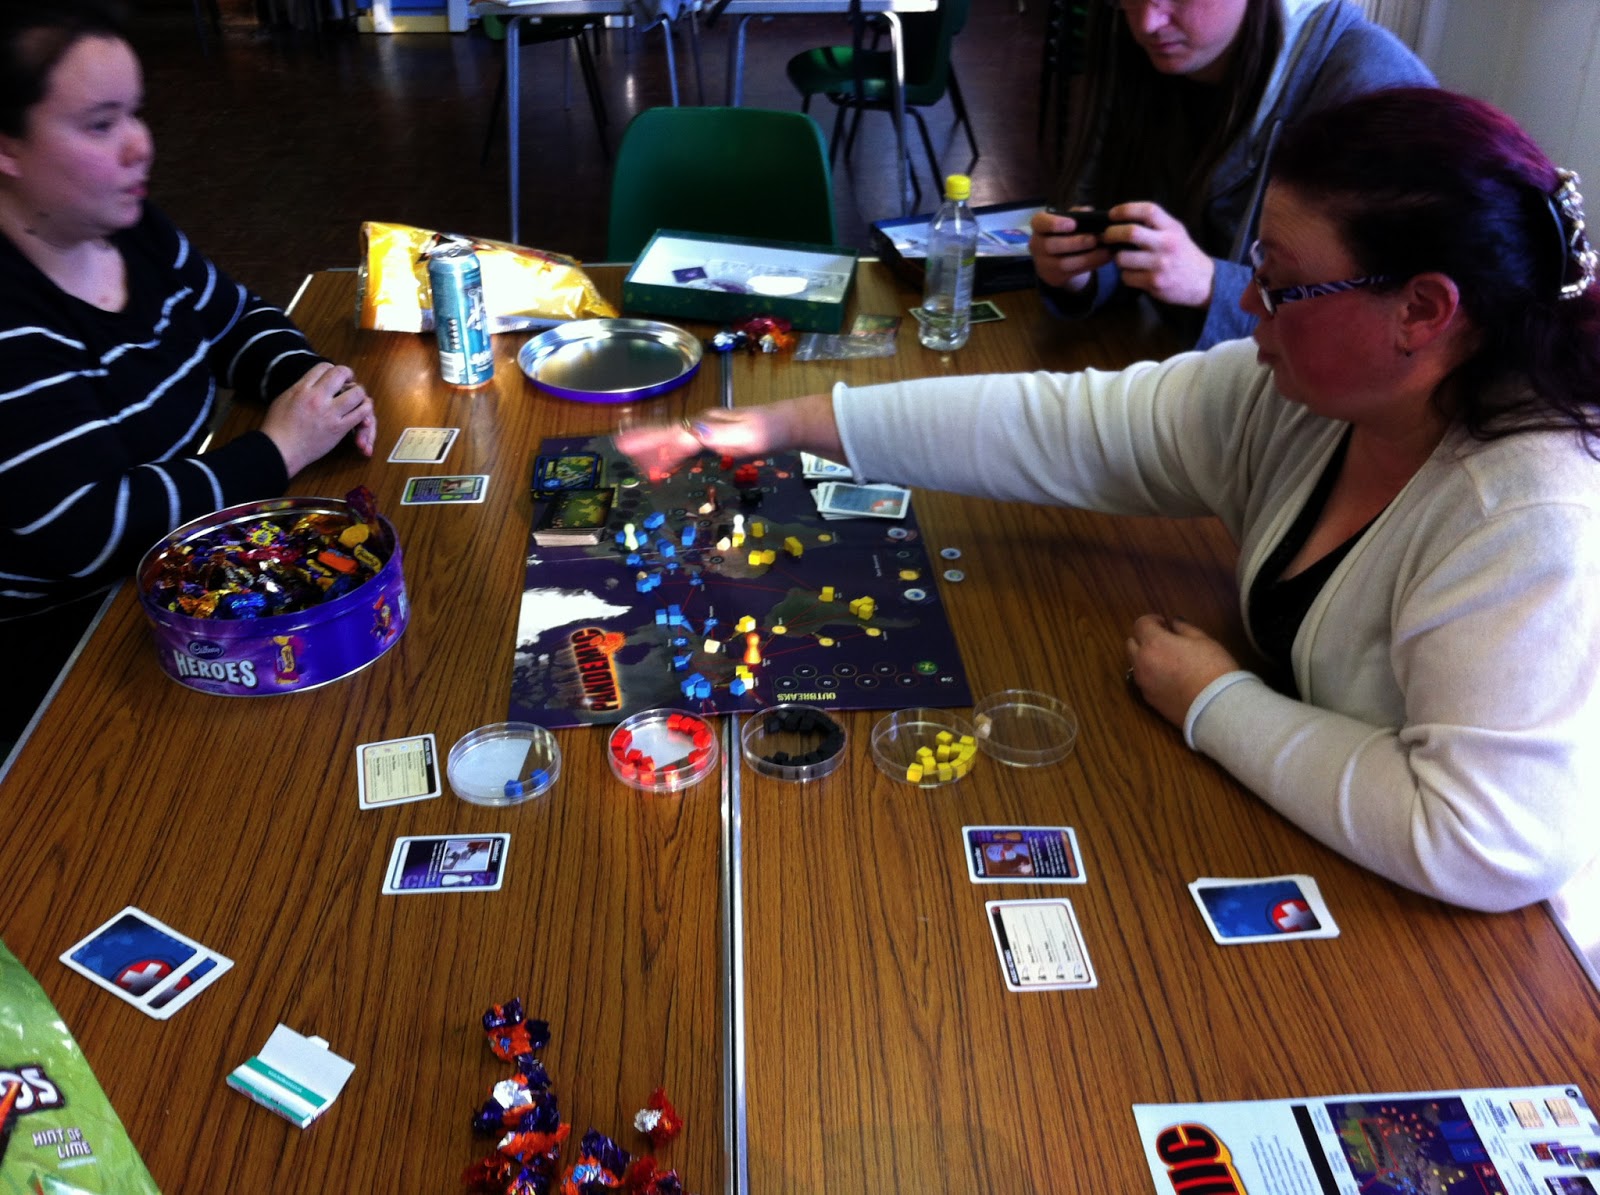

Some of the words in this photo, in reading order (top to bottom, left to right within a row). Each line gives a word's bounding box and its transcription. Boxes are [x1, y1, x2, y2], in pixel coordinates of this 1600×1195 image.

[172, 649, 258, 688] HEROES
[571, 628, 620, 711] PANDEMIC
[776, 692, 837, 702] OUTBREAKS
[32, 1128, 65, 1147] HINT
[66, 1127, 82, 1141] OF
[57, 1140, 93, 1159] LIME
